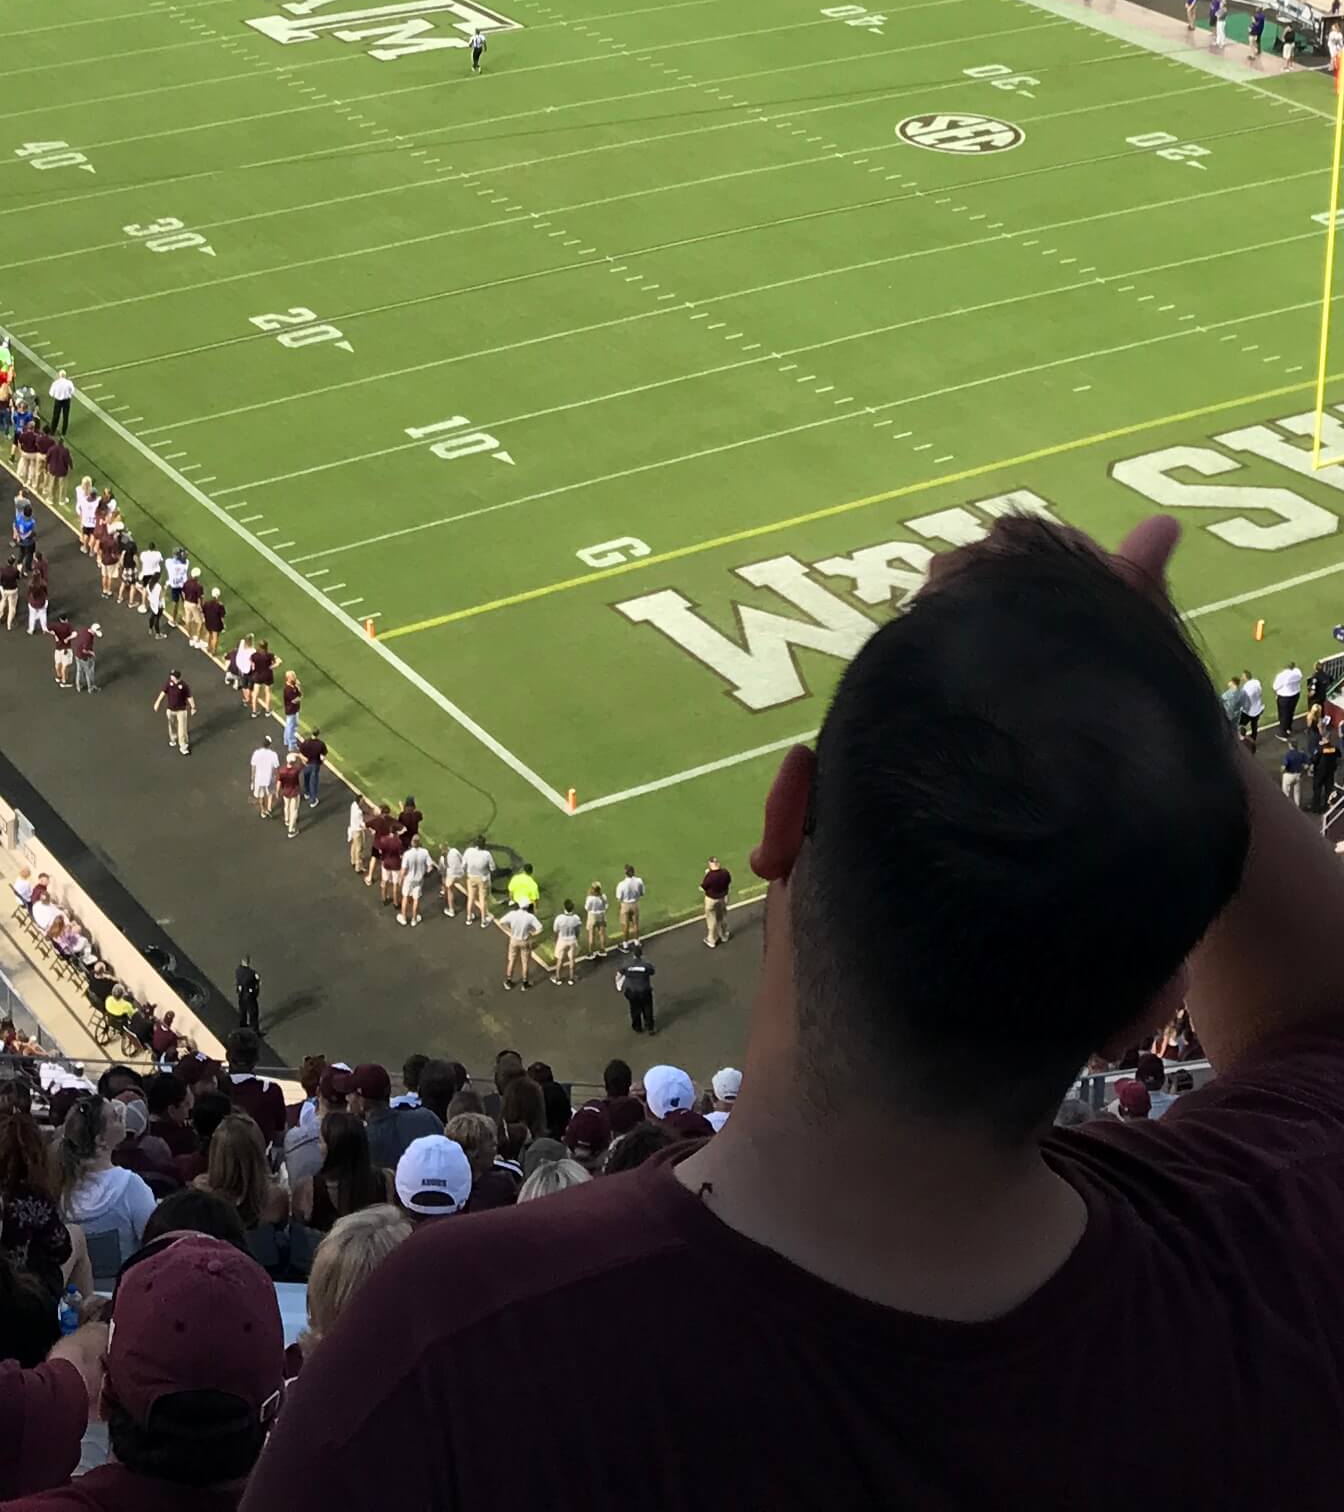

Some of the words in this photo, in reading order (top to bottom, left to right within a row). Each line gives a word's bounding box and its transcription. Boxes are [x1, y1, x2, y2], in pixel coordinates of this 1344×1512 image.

[819, 5, 888, 27] 40
[962, 64, 1042, 91] 30
[899, 115, 1022, 153] SEC
[1125, 132, 1213, 161] 20
[12, 140, 89, 171] 40
[123, 217, 206, 253] 30
[248, 307, 341, 349] 20
[400, 415, 499, 461] 10
[575, 536, 652, 569] G
